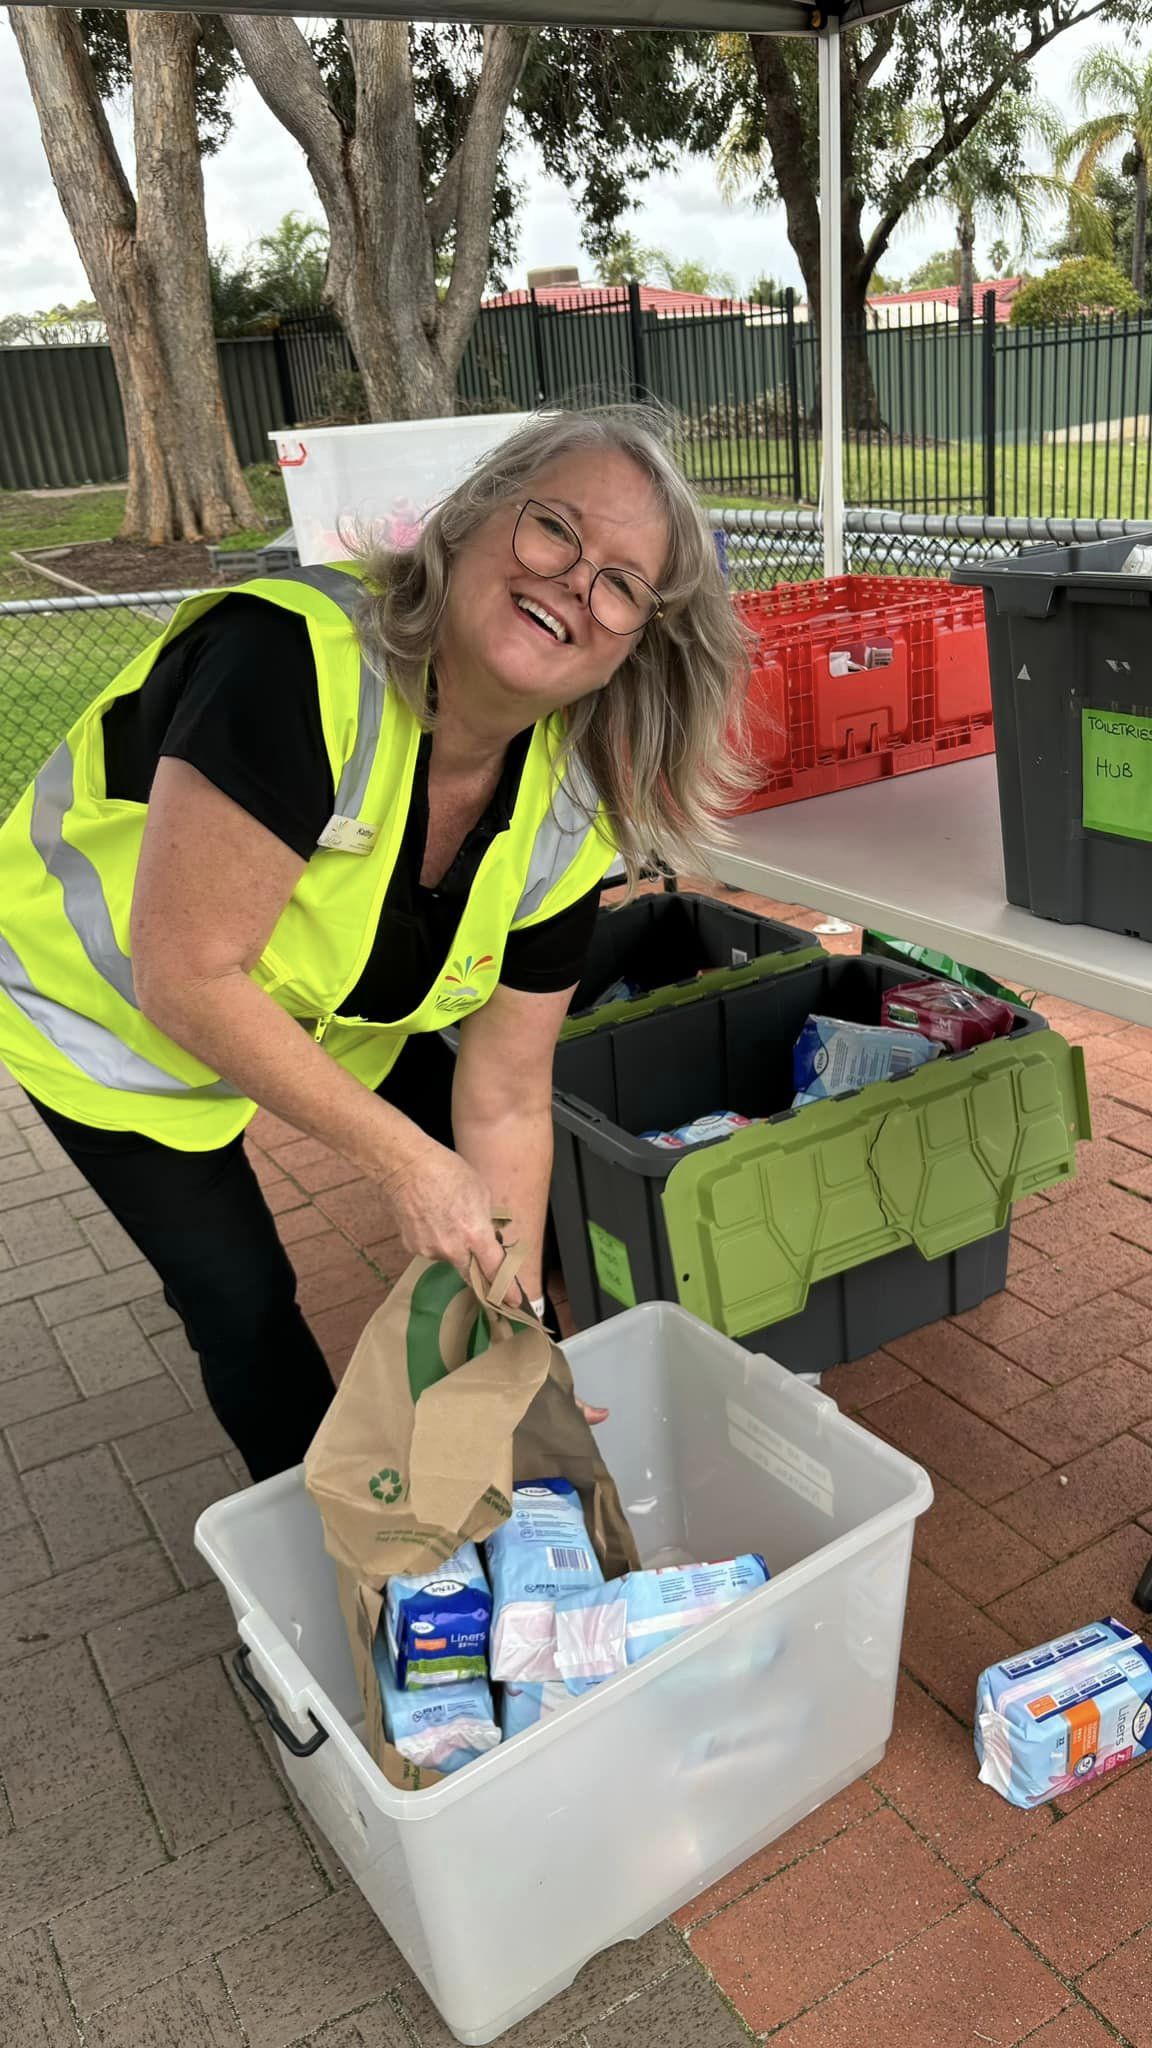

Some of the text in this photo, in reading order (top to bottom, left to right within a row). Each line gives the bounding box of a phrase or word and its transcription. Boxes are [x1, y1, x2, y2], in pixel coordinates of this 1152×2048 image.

[1096, 757, 1133, 778] HUB
[450, 1631, 486, 1643] Liners
[1115, 1704, 1130, 1746] Liners
